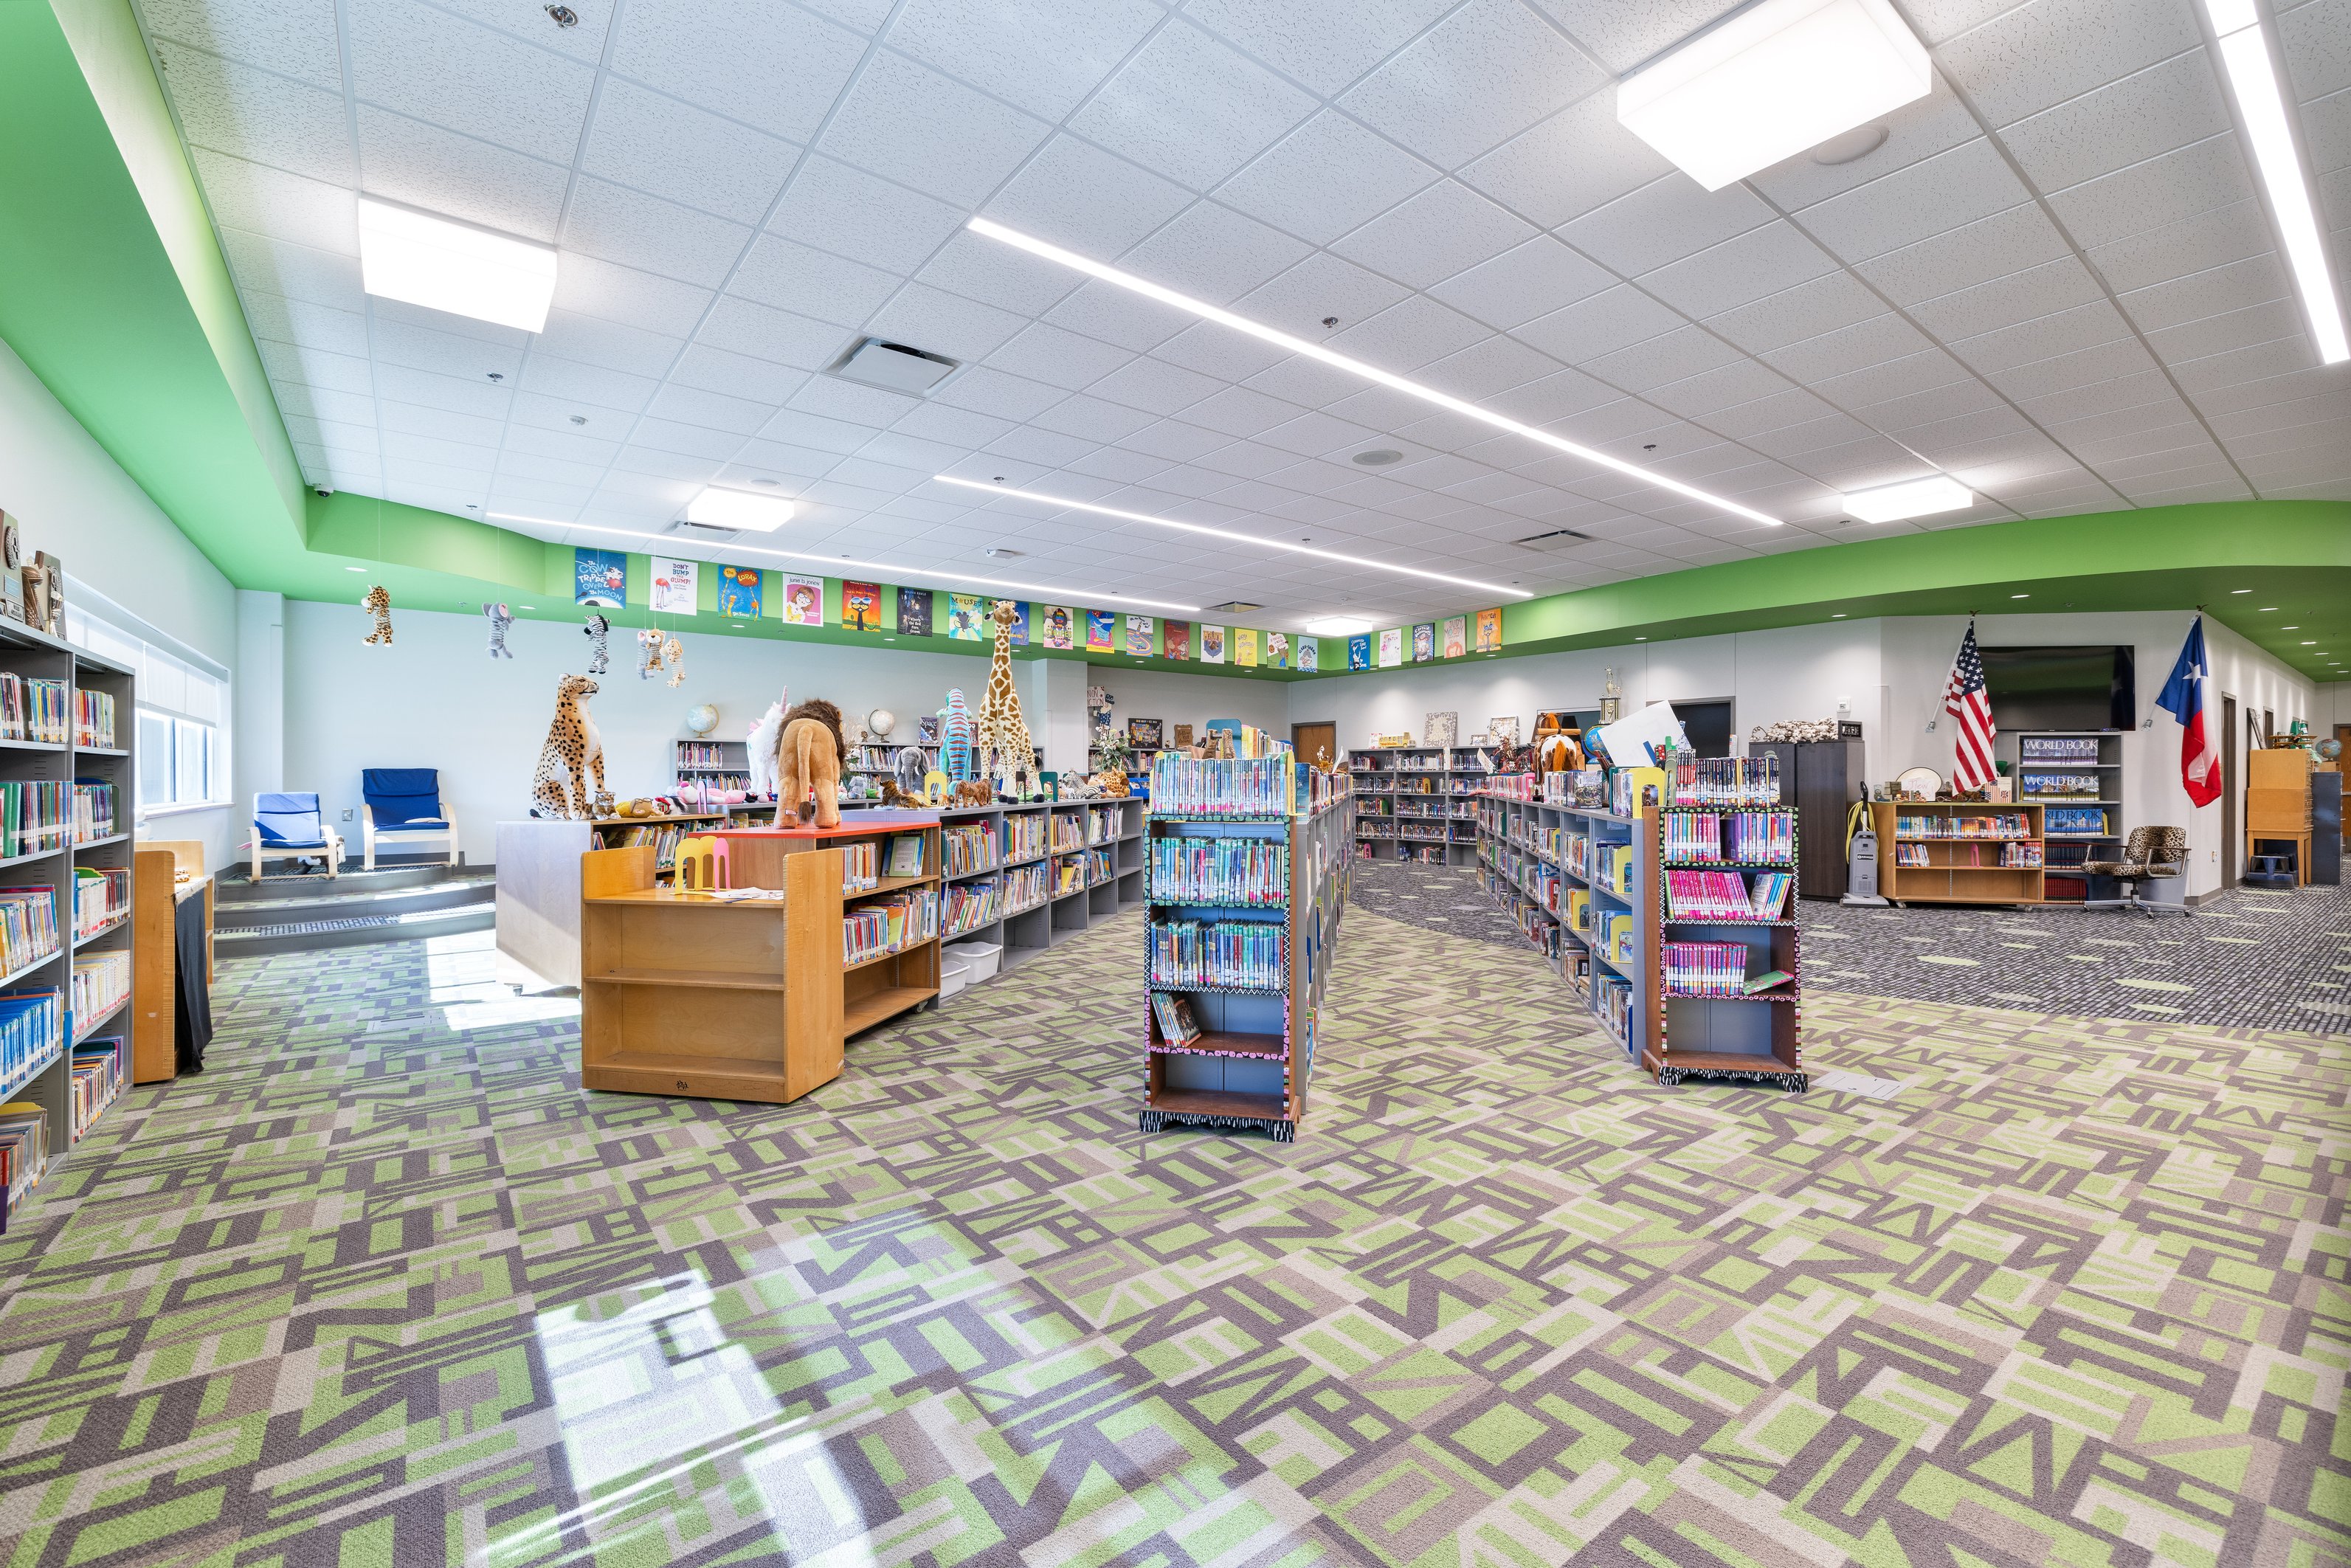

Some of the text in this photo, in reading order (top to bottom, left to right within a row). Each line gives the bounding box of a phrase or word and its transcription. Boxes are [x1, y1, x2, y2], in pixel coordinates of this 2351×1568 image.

[579, 564, 609, 574] COW
[672, 568, 689, 576] BUMP
[670, 577, 691, 585] GLUMP!
[738, 573, 757, 582] LORAX
[582, 582, 603, 590] OVER
[598, 590, 623, 601] MOON
[950, 596, 982, 607] MUSE'S
[1087, 698, 1104, 707] ICTION
[921, 719, 937, 728] Space
[2024, 739, 2099, 750] WORLD BOOK
[2024, 776, 2099, 786] WORLD BOOK
[2046, 809, 2101, 820] RLD BOOK
